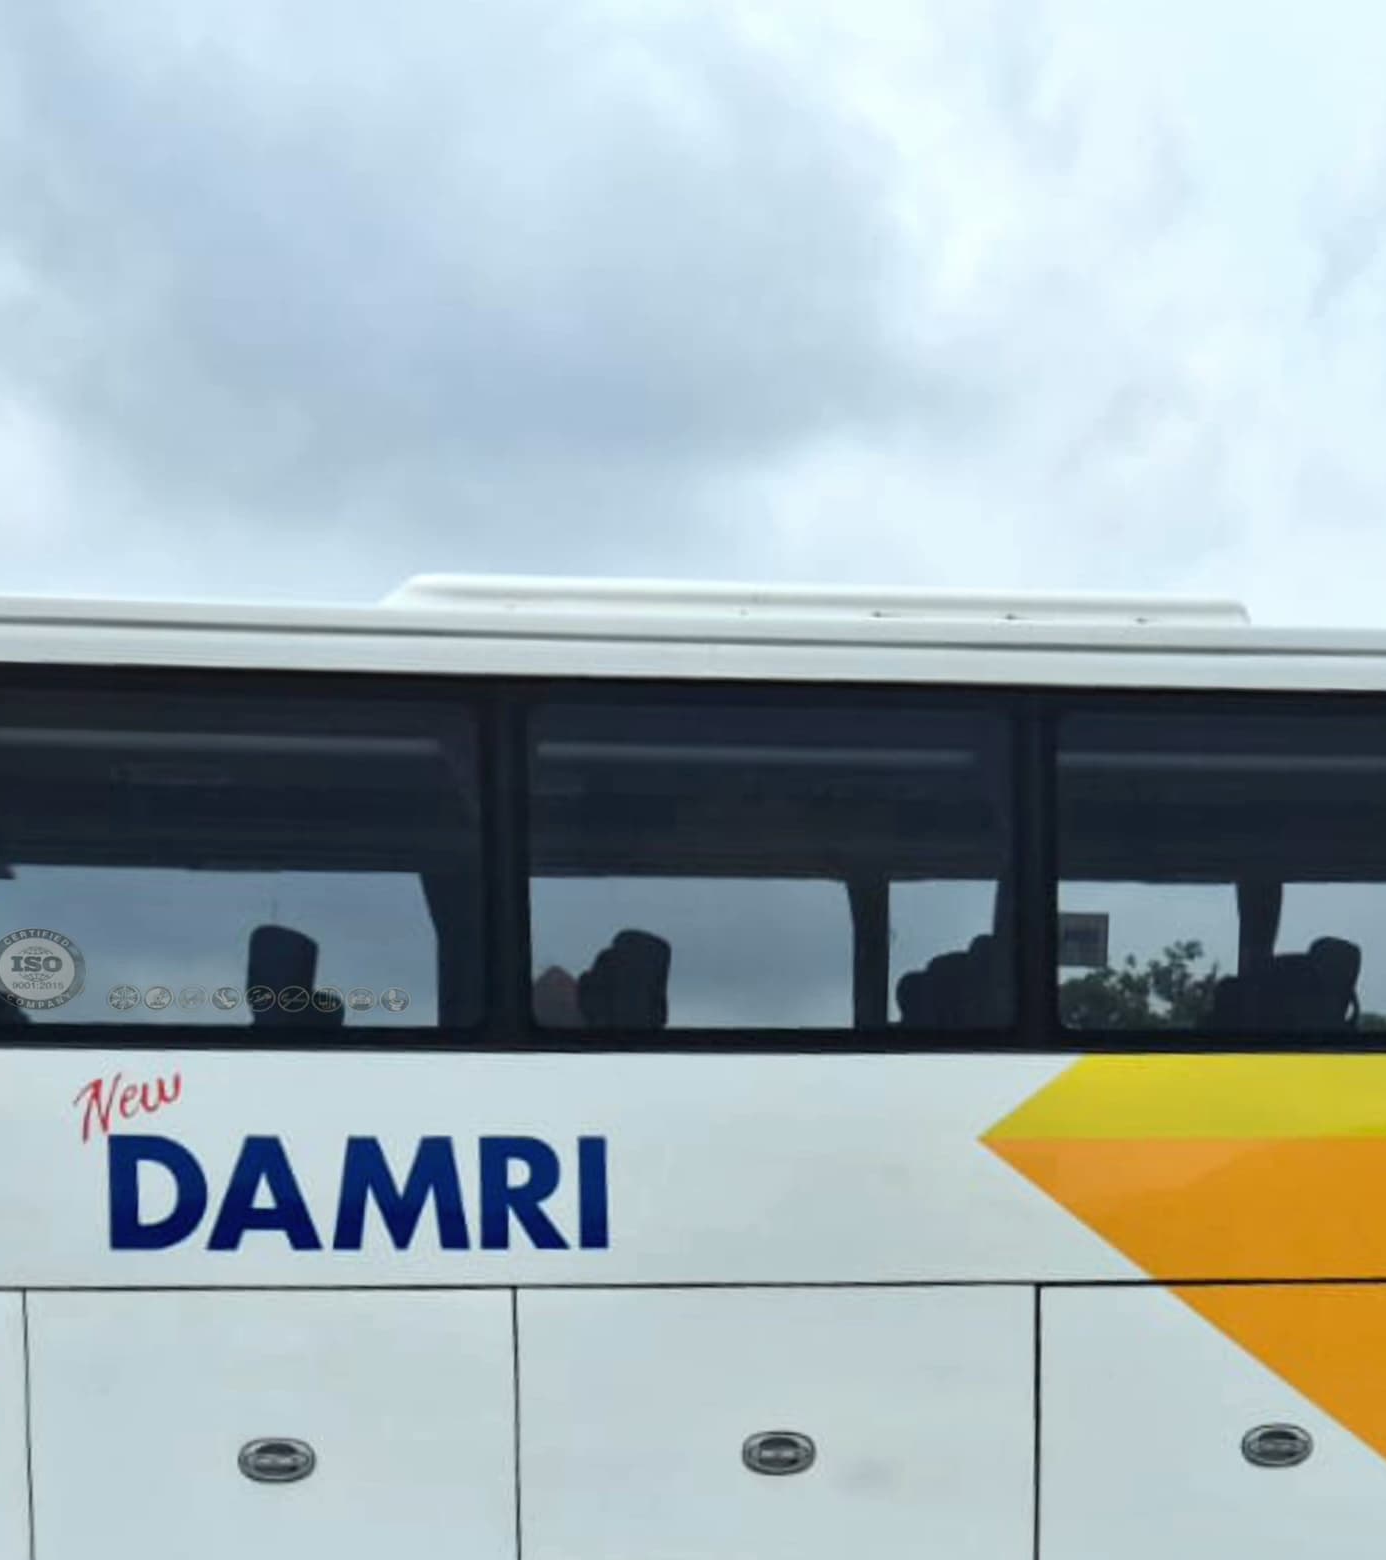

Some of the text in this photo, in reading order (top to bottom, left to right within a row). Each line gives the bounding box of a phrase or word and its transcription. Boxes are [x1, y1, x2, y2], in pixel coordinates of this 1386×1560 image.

[3, 929, 70, 948] CERTIFIED
[10, 955, 63, 973] ISO
[12, 981, 65, 991] 9001:2015
[6, 992, 71, 1010] COMPANY
[72, 1070, 183, 1142] New
[107, 1134, 609, 1252] DAMRI
